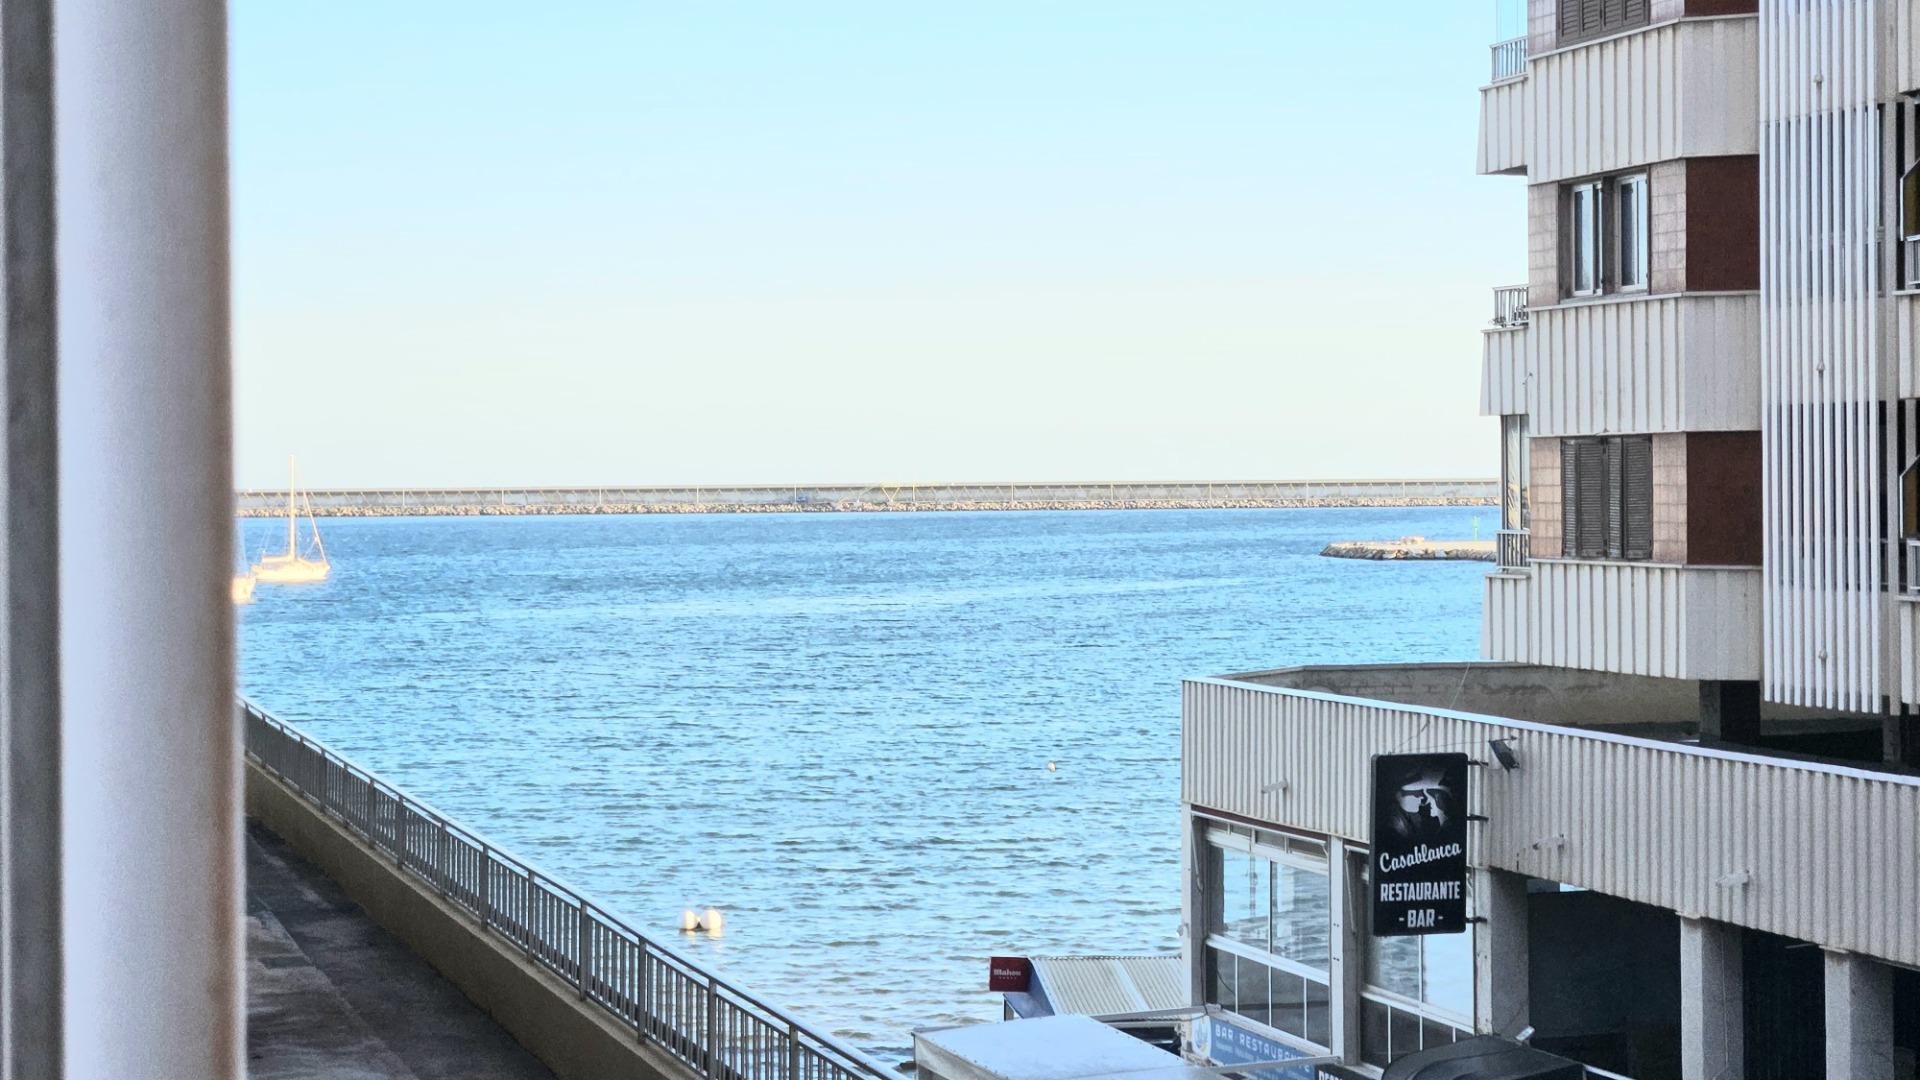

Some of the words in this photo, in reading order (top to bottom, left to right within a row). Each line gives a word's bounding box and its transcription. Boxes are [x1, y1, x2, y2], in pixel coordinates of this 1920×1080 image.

[1380, 843, 1462, 873] Casablanca
[1380, 881, 1461, 902] RESTAURANTE
[1215, 1023, 1234, 1041] BAR
